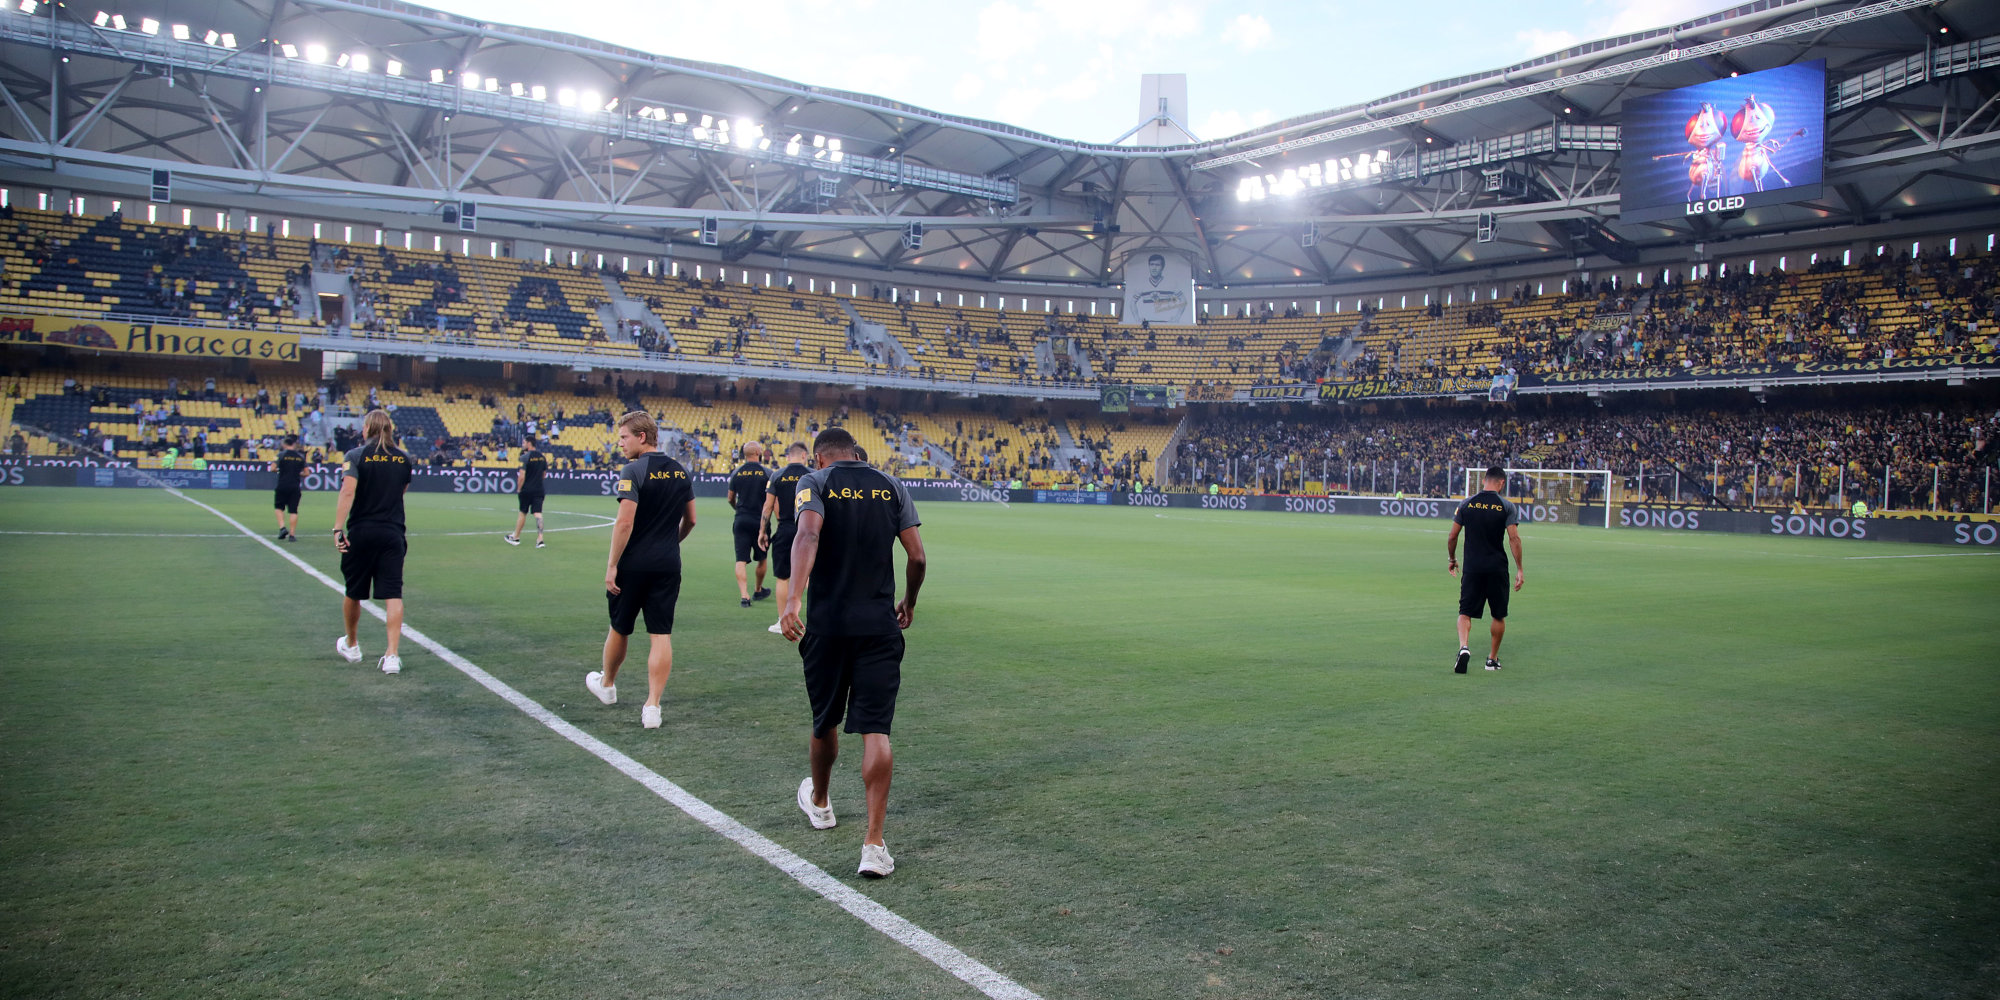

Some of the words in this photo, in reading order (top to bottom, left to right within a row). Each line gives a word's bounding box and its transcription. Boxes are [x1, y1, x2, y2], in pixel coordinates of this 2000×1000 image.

[1686, 202, 1704, 215] LG
[1707, 196, 1745, 212] OLED
[126, 324, 298, 360] Anacasa
[392, 456, 405, 464] FC
[674, 471, 686, 480] FC
[453, 477, 517, 494] SONO
[871, 489, 892, 501] FC
[961, 488, 1010, 502] SONOS
[1127, 492, 1169, 507] SONOS
[1201, 494, 1248, 510] SONOS
[1285, 497, 1336, 514] SONOS
[1380, 500, 1439, 518] SONOS
[1491, 504, 1503, 512] FC
[1517, 503, 1559, 523] NOS
[1619, 508, 1700, 530] SONOS
[1770, 514, 1867, 539] SONOS
